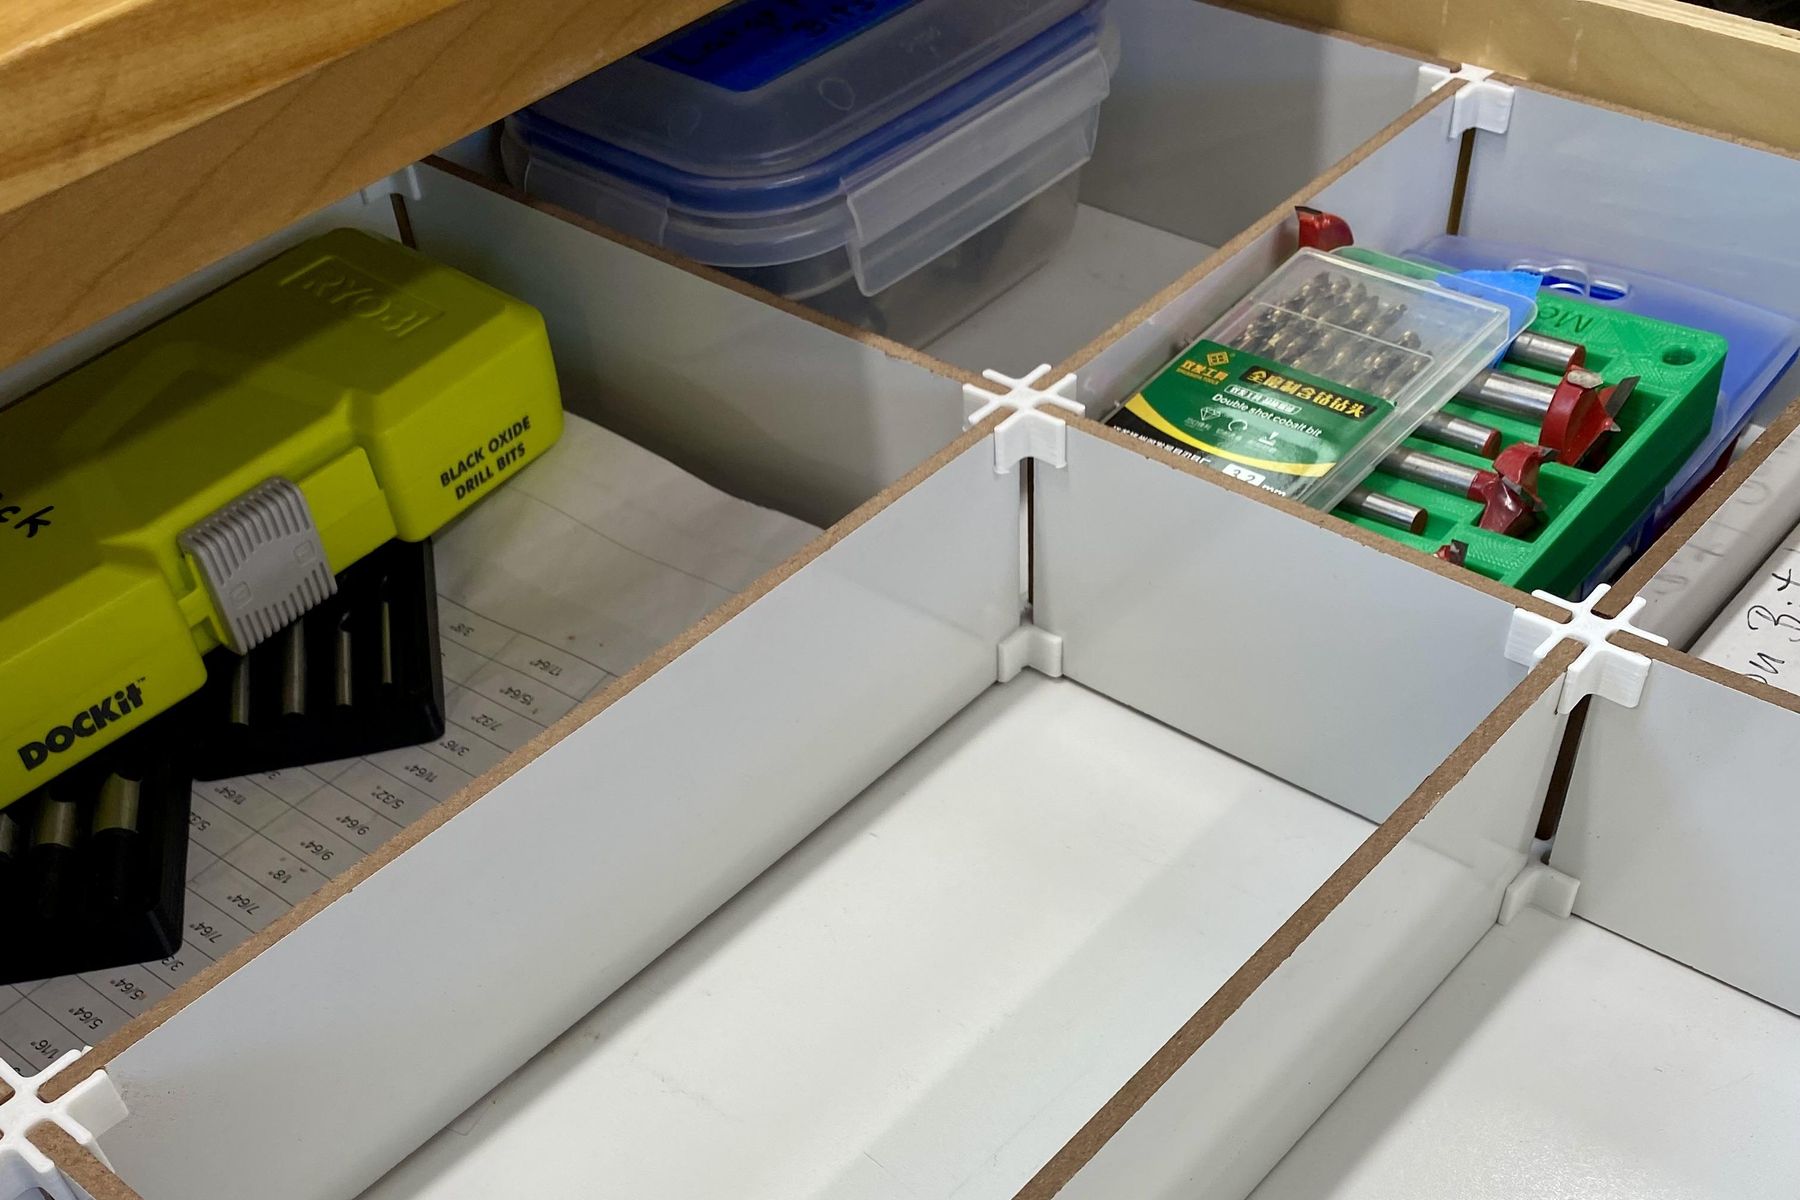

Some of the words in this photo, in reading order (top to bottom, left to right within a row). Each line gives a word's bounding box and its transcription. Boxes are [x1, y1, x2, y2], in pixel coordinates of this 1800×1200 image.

[302, 270, 431, 338] RYOBI
[1538, 306, 1593, 333] Me
[1212, 393, 1249, 411] Double
[1249, 406, 1275, 421] shot
[1273, 414, 1306, 431] cobalt
[1306, 426, 1322, 437] bit
[440, 447, 485, 488] BLACK
[488, 415, 530, 453] OXIDE
[455, 466, 494, 500] DRILL
[497, 442, 526, 471] BITS
[471, 714, 502, 731] 7/32"
[371, 790, 405, 810] 5/32"
[336, 815, 370, 835] 9/64"
[300, 841, 334, 861] 9/64"
[268, 869, 292, 884] 1/8"
[227, 894, 260, 915] 7/64"
[189, 922, 222, 943] 7/64"
[110, 978, 144, 1000] 5/64"
[68, 1007, 103, 1030] 5/64"
[30, 1040, 59, 1059] 1/16"
